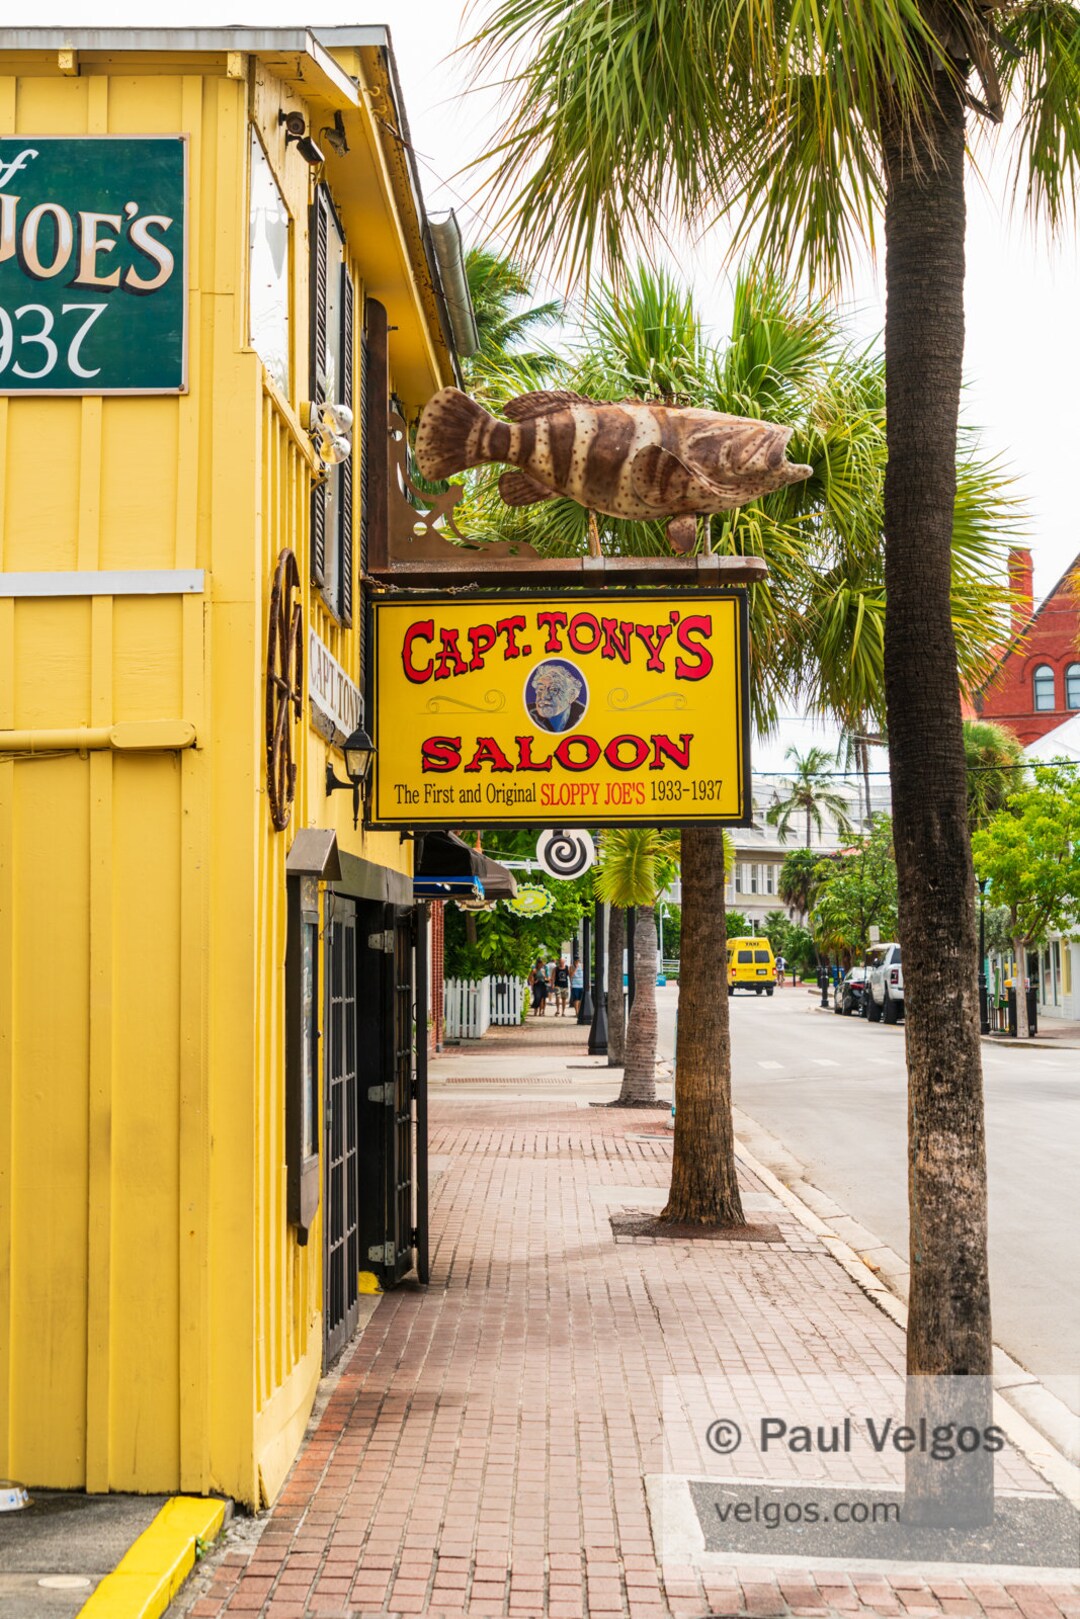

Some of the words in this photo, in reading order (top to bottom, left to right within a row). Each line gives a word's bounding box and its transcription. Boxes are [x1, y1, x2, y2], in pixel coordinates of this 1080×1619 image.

[0, 149, 39, 188] f
[401, 615, 532, 684] CAPT.
[537, 610, 714, 682] TONY'S
[421, 734, 694, 773] SALOON
[394, 784, 420, 804] The
[423, 783, 454, 804] First
[459, 783, 482, 804] and
[486, 782, 537, 806] Original
[540, 783, 600, 806] SLOPPY
[604, 782, 646, 805] JOE'S
[651, 780, 722, 801] 1933-1937
